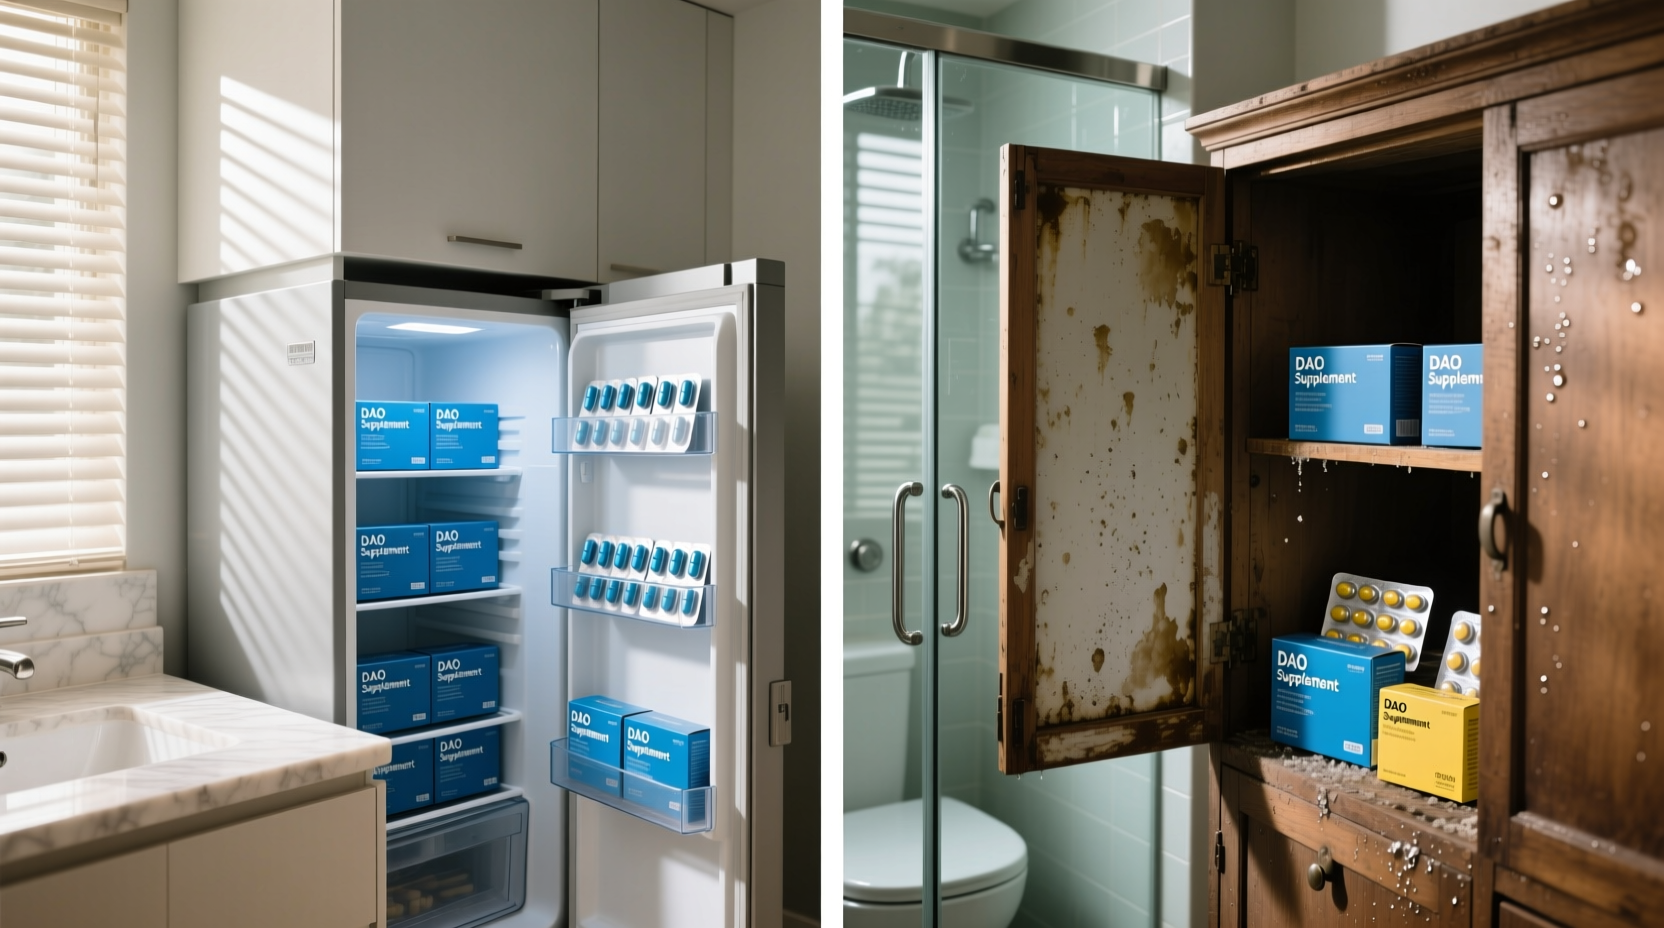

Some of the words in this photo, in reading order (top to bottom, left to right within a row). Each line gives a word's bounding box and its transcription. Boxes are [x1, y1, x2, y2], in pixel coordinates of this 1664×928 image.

[1295, 356, 1325, 371] DAO
[1429, 354, 1462, 370] DAO
[361, 407, 386, 419] DAO
[436, 409, 459, 420] DAO
[361, 534, 385, 546] DAO
[436, 530, 459, 542] DAO
[437, 659, 460, 672] DAO
[1277, 650, 1308, 671] DAO
[362, 669, 386, 682] DAO
[1384, 698, 1407, 713] DAO
[571, 710, 591, 726] DAO
[627, 727, 650, 743] DAO
[440, 738, 462, 752] DAO
